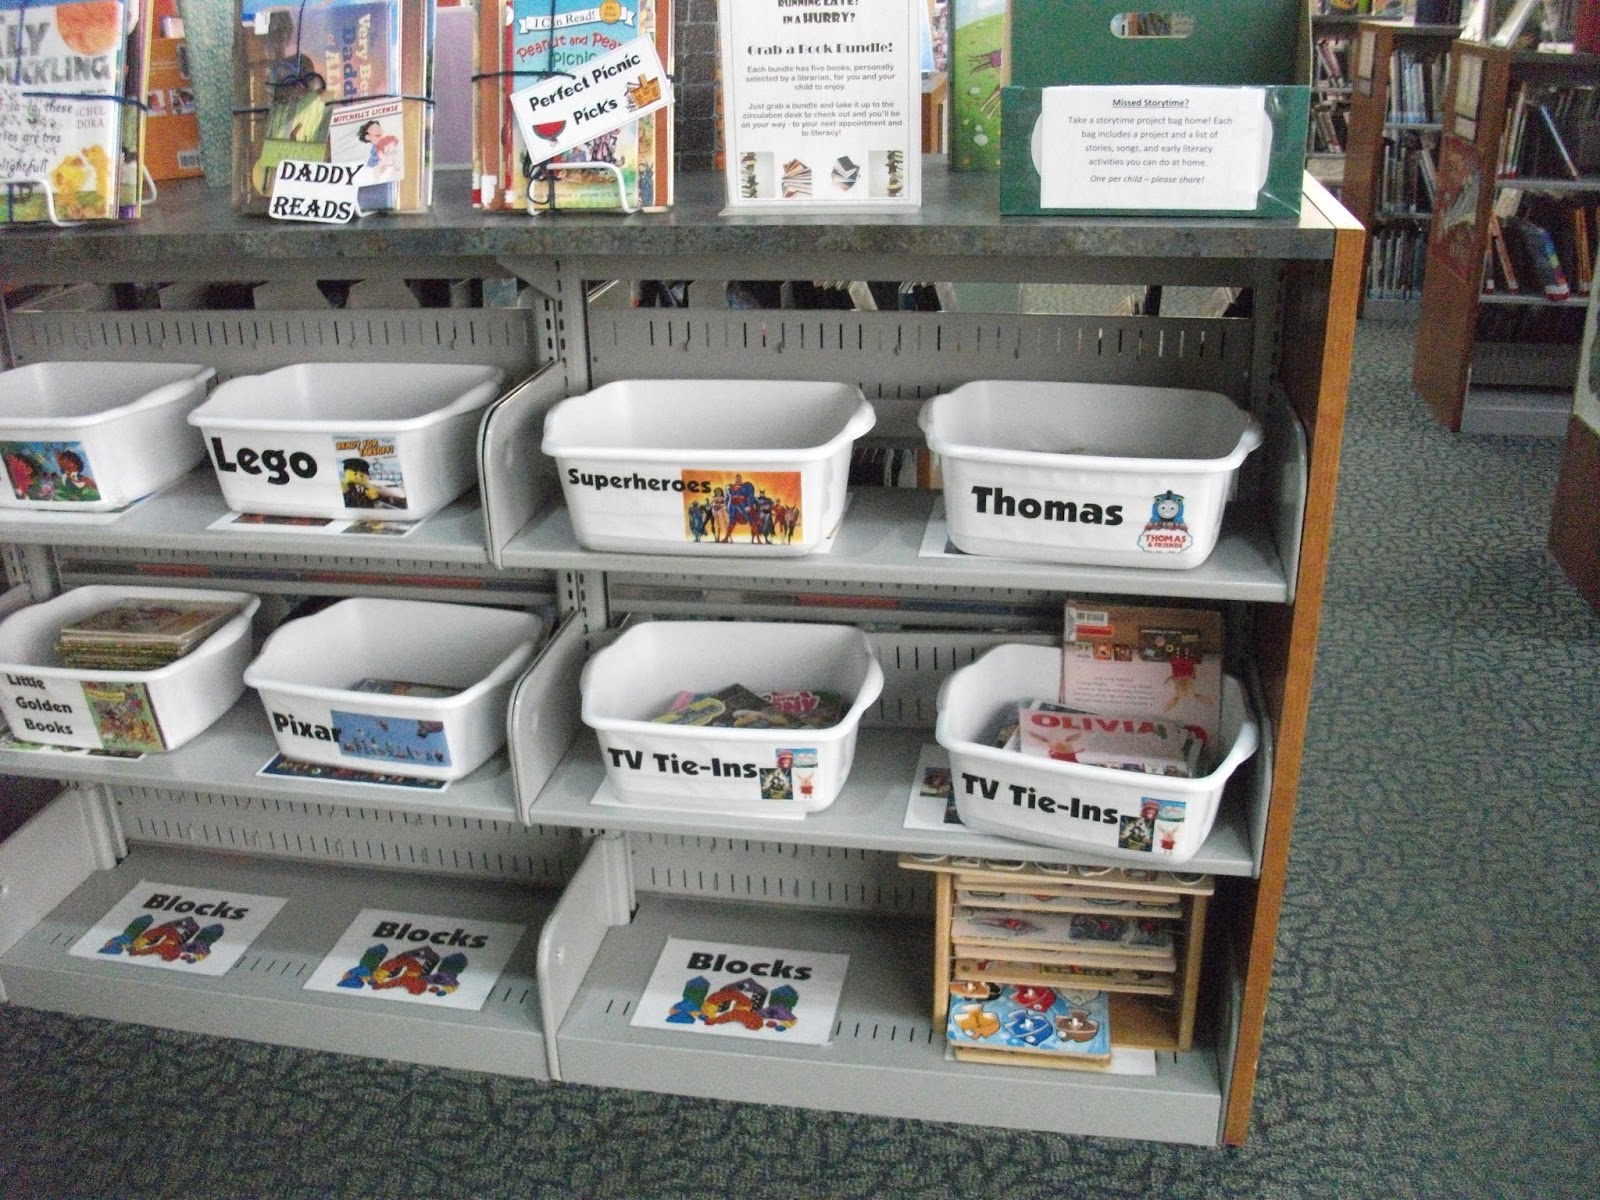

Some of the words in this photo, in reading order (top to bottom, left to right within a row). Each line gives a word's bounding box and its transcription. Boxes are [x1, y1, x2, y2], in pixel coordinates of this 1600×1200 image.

[534, 19, 539, 28] I
[541, 18, 563, 28] Cn
[565, 11, 596, 25] Read!
[783, 16, 793, 24] IN
[803, 12, 856, 24] HURRY?
[569, 35, 589, 46] and
[747, 45, 782, 55] Grab
[786, 46, 795, 54] a
[799, 44, 833, 54] Book
[836, 42, 893, 54] Bundle!
[854, 64, 894, 73] personally
[529, 76, 590, 111] Perfect
[592, 53, 641, 84] Picnic
[780, 75, 789, 83] by
[797, 74, 832, 82] librarian,
[824, 84, 846, 92] enjoy.
[766, 103, 783, 111] grab
[861, 102, 870, 110] up
[1112, 99, 1141, 107] Missed
[1144, 99, 1189, 108] Storytime?
[333, 110, 370, 123] MITCHELL'S
[372, 104, 399, 115] LICENSE
[573, 99, 618, 126] Picks
[868, 110, 889, 118] you'll
[801, 121, 818, 129] your
[838, 120, 886, 128] appointment
[1096, 117, 1135, 125] storytime
[1137, 117, 1165, 126] project
[1168, 117, 1182, 126] bag
[1213, 117, 1232, 125] Each
[811, 129, 842, 137] literacy!
[1081, 131, 1096, 139] bag
[1140, 131, 1168, 139] project
[1117, 146, 1141, 154] songs,
[1161, 145, 1181, 153] early
[1183, 145, 1213, 153] literacy
[280, 161, 364, 186] DADDY
[1123, 175, 1142, 183] child
[1151, 176, 1177, 184] please
[272, 196, 353, 220] READS
[211, 437, 318, 486] Lego
[567, 468, 712, 494] Superheroes
[971, 485, 1123, 526] Thomas
[1145, 534, 1187, 542] THOMAS
[6, 673, 46, 690] Little
[15, 696, 72, 713] Golden
[23, 718, 73, 734] Books
[272, 711, 342, 743] Pixar
[1031, 713, 1155, 734] OLIVIA
[607, 747, 643, 770] TV
[652, 752, 759, 779] Tie-Ins
[961, 772, 1002, 801] TV
[1008, 784, 1118, 825] Tie-Ins
[141, 893, 249, 920] Blocks
[372, 920, 488, 950] Blocks
[686, 951, 814, 981] Blocks
